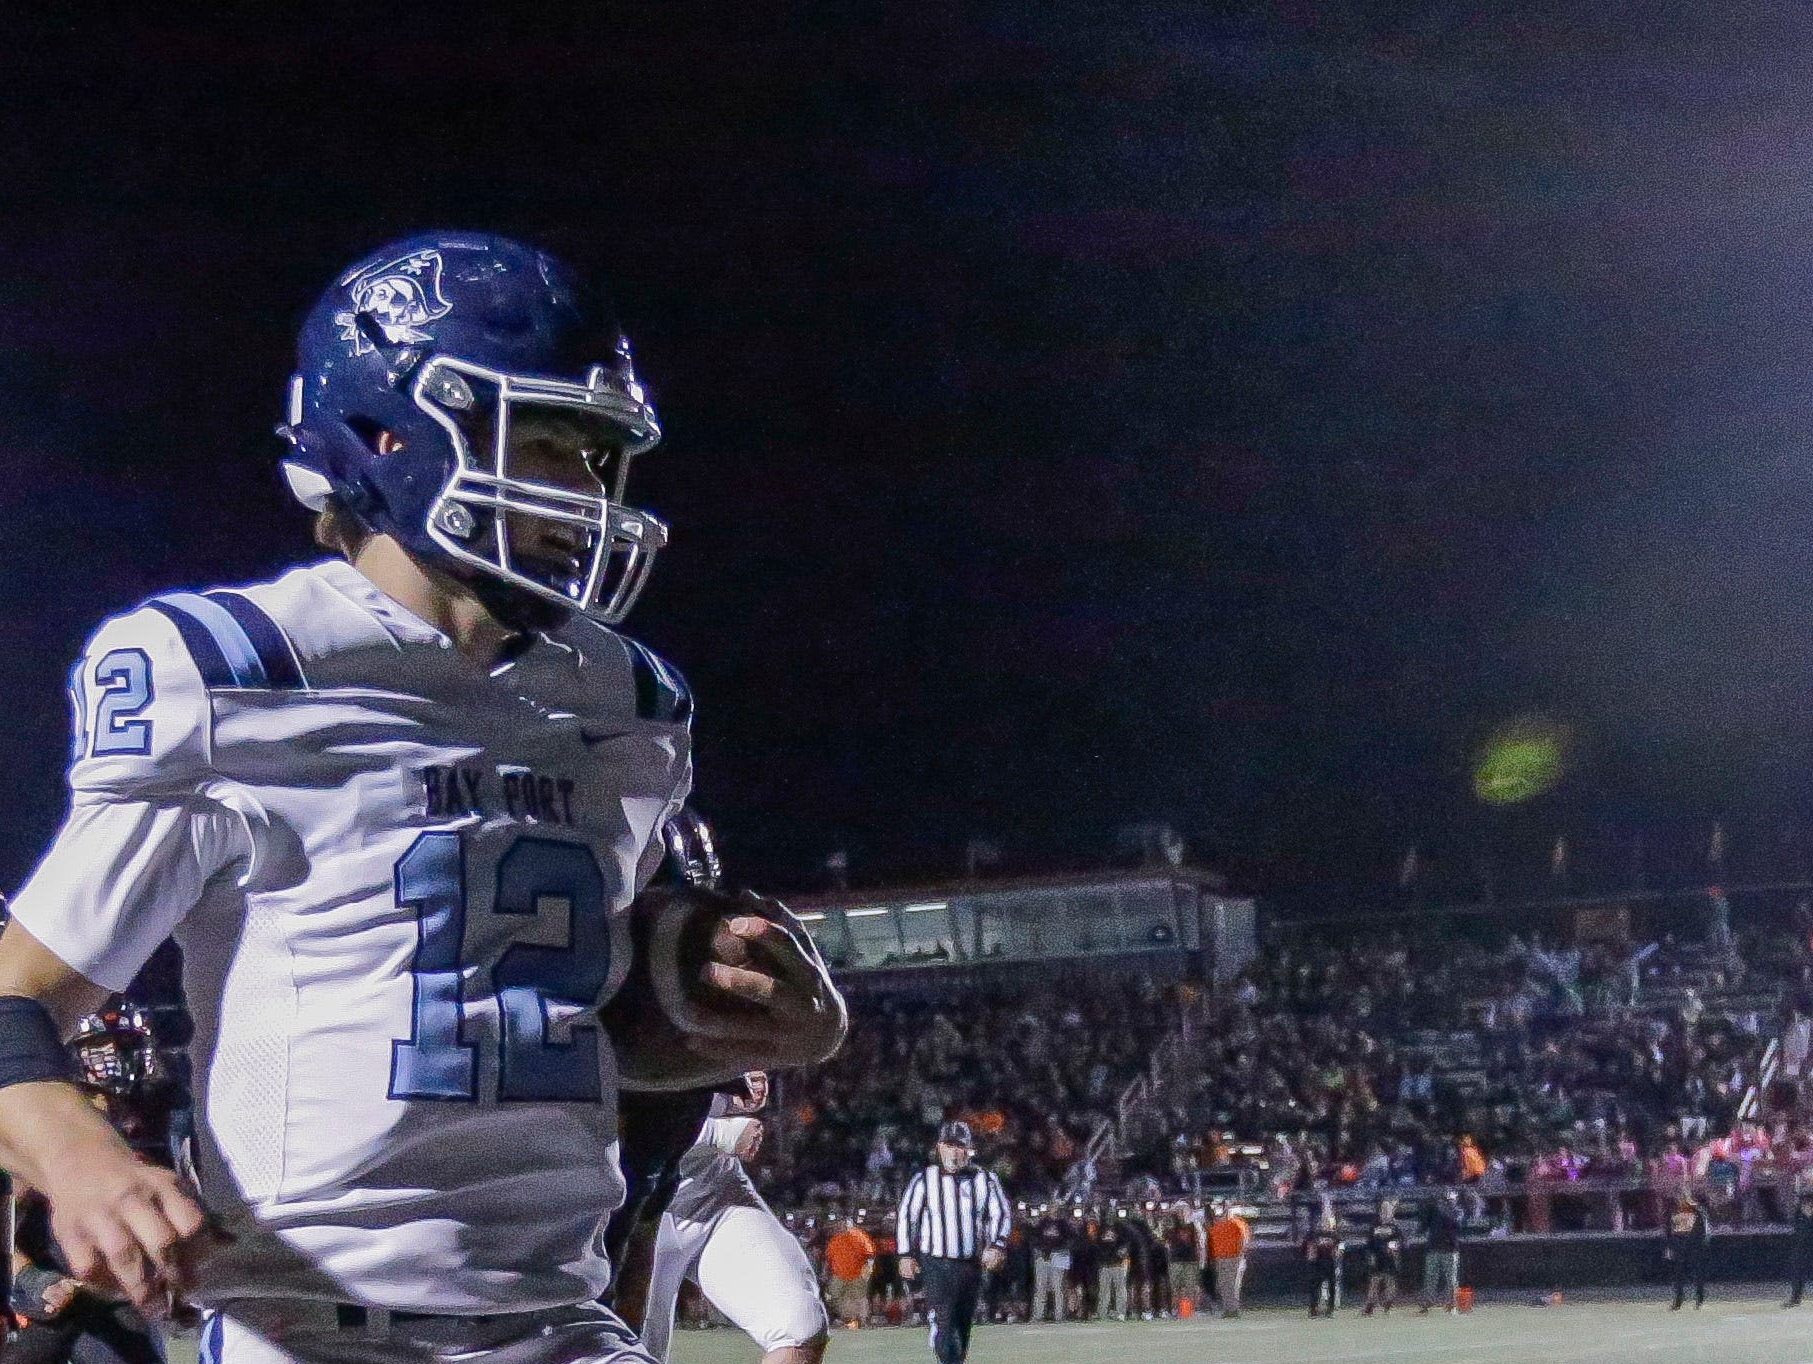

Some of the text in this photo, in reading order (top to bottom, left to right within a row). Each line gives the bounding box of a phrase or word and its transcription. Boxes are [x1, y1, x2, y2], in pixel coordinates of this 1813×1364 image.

[70, 647, 154, 757] 12
[424, 765, 575, 824] BAY PORT
[389, 830, 611, 1102] 12
